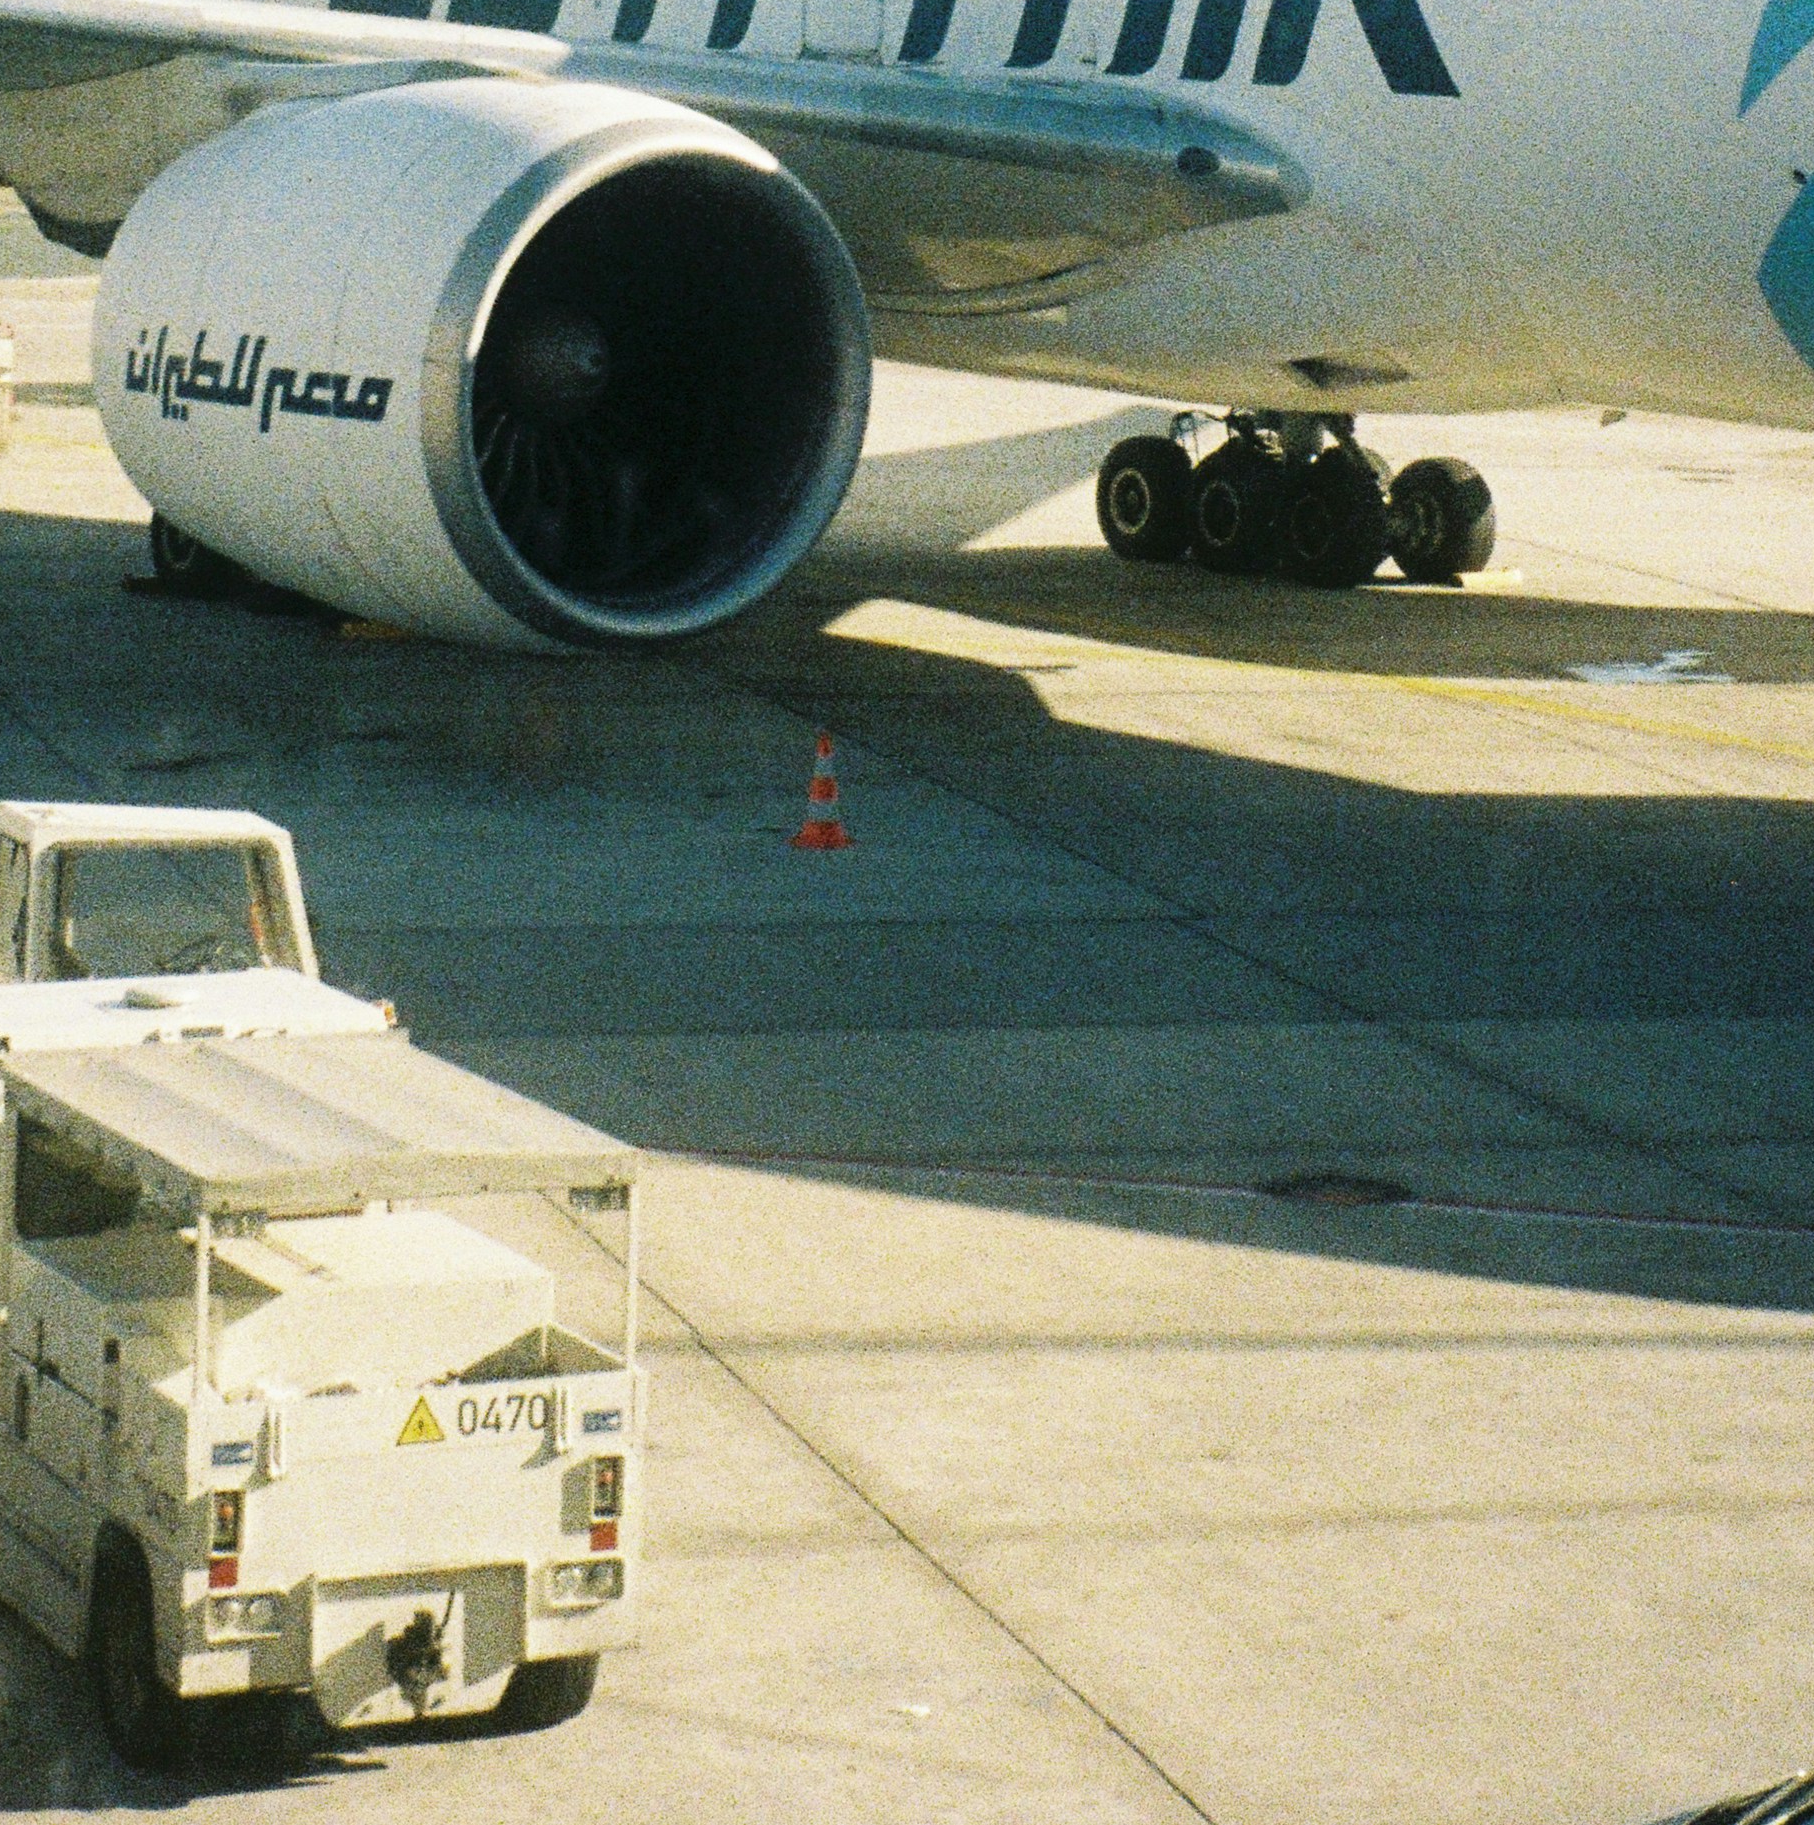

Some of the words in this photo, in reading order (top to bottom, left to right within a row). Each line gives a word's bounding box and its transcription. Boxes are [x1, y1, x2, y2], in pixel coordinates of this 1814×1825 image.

[126, 325, 267, 422] للطيران
[260, 366, 394, 434] مصر
[457, 1392, 547, 1436] 0470
